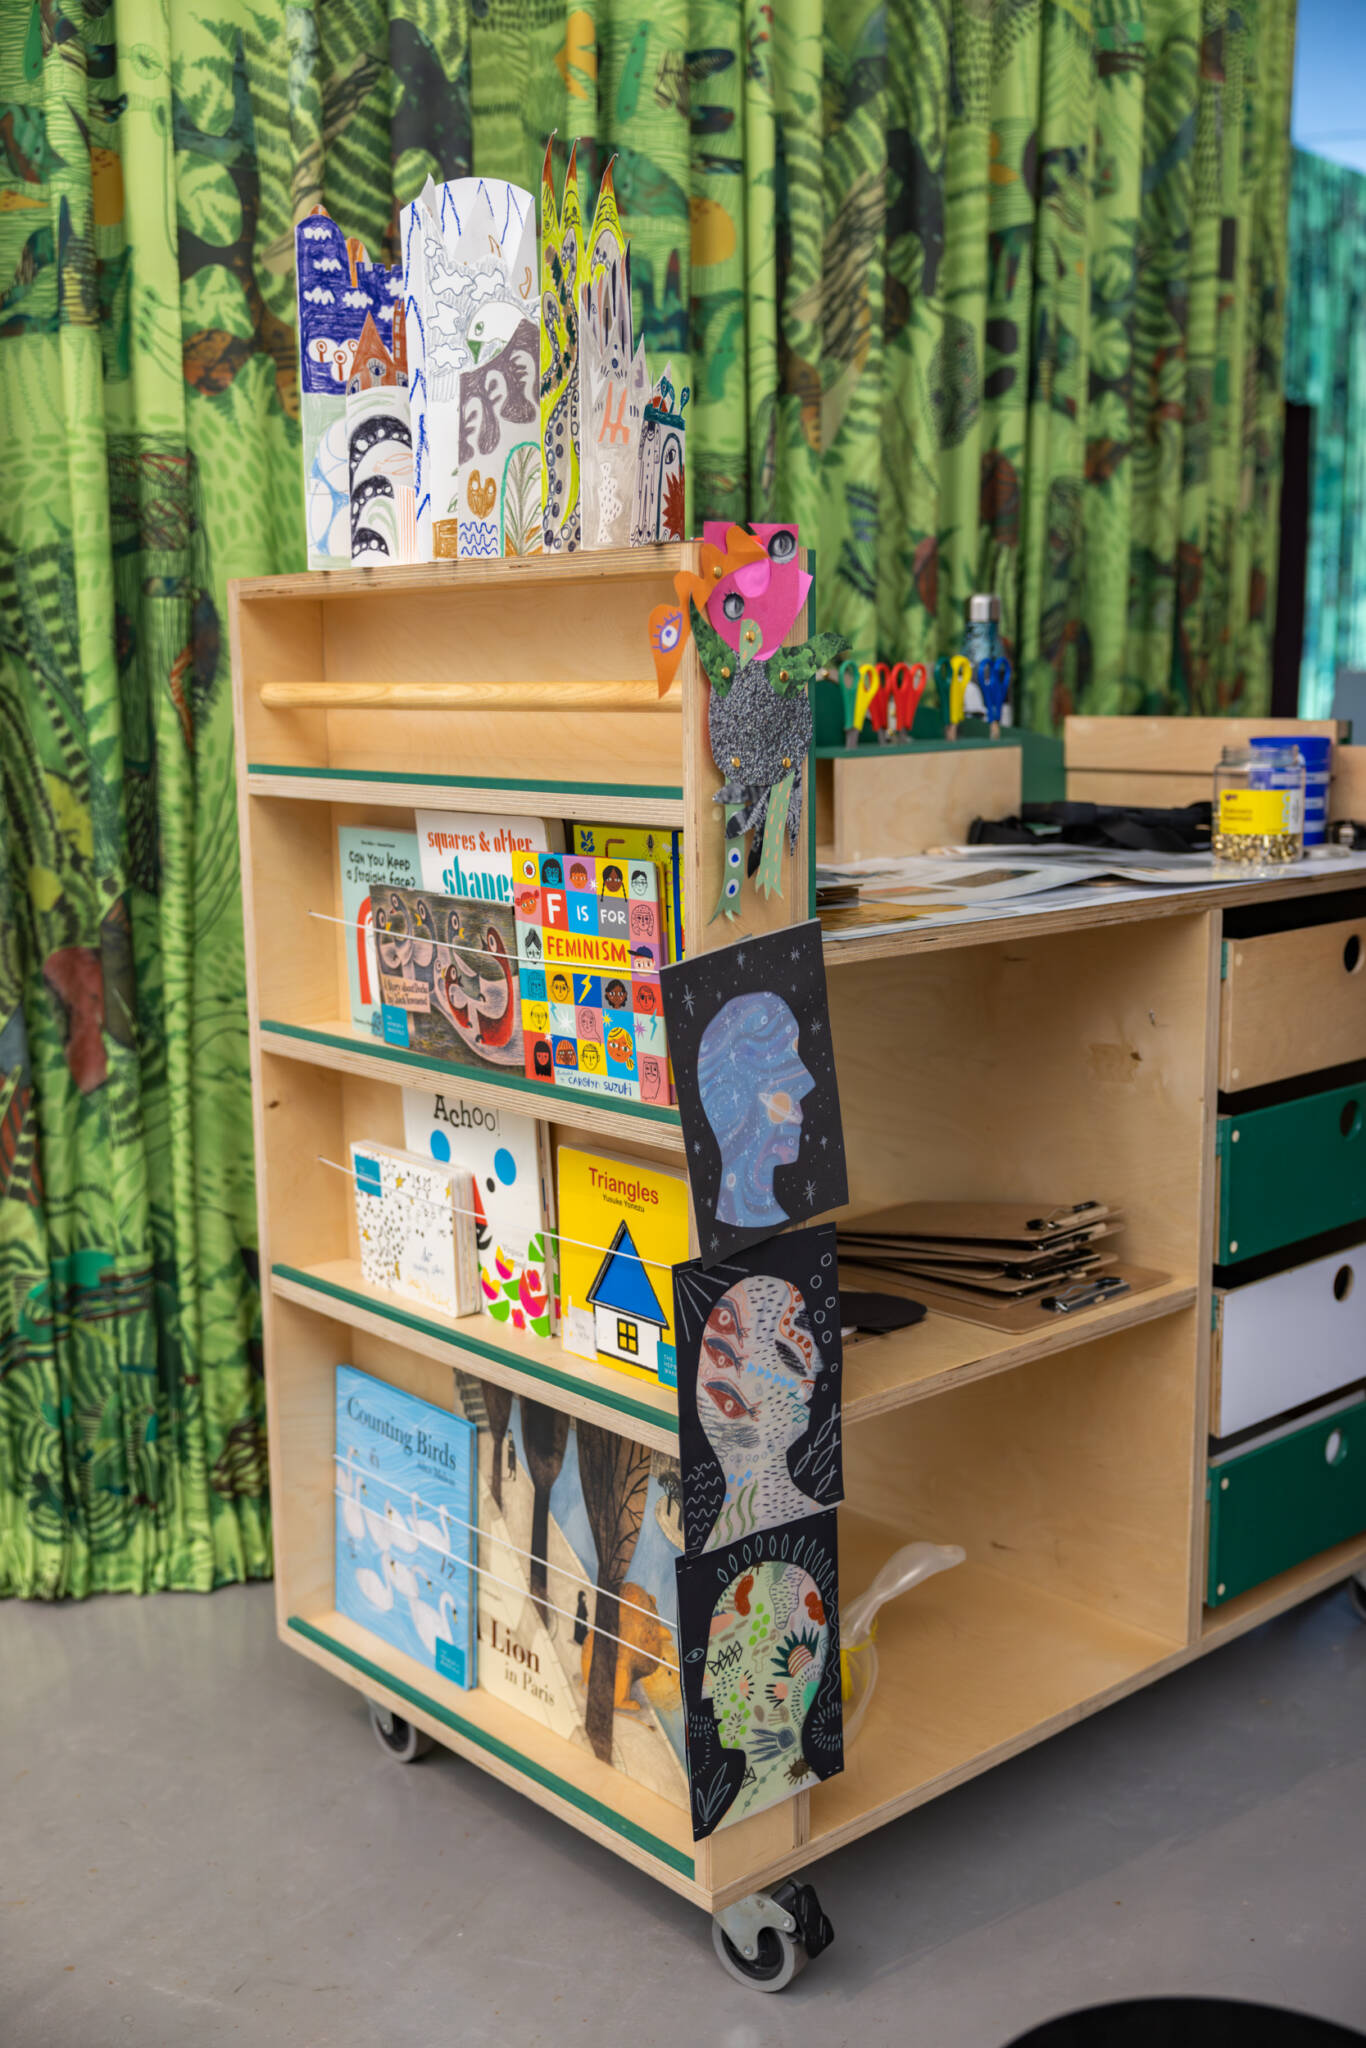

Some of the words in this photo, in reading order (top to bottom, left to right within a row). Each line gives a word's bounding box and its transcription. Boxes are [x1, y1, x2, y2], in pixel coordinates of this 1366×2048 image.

[427, 831, 476, 856] squares
[479, 830, 491, 852] &
[494, 828, 532, 853] other
[442, 855, 514, 902] shape
[547, 893, 562, 924] F
[576, 905, 589, 922] IS
[600, 909, 627, 925] FOR
[547, 935, 627, 963] FEMINISM
[588, 1167, 659, 1204] Triangles
[348, 1396, 413, 1456] Counting
[417, 1429, 456, 1471] Birds
[490, 1617, 540, 1673] Lion
[505, 1661, 517, 1685] in
[523, 1671, 555, 1706] Paris
